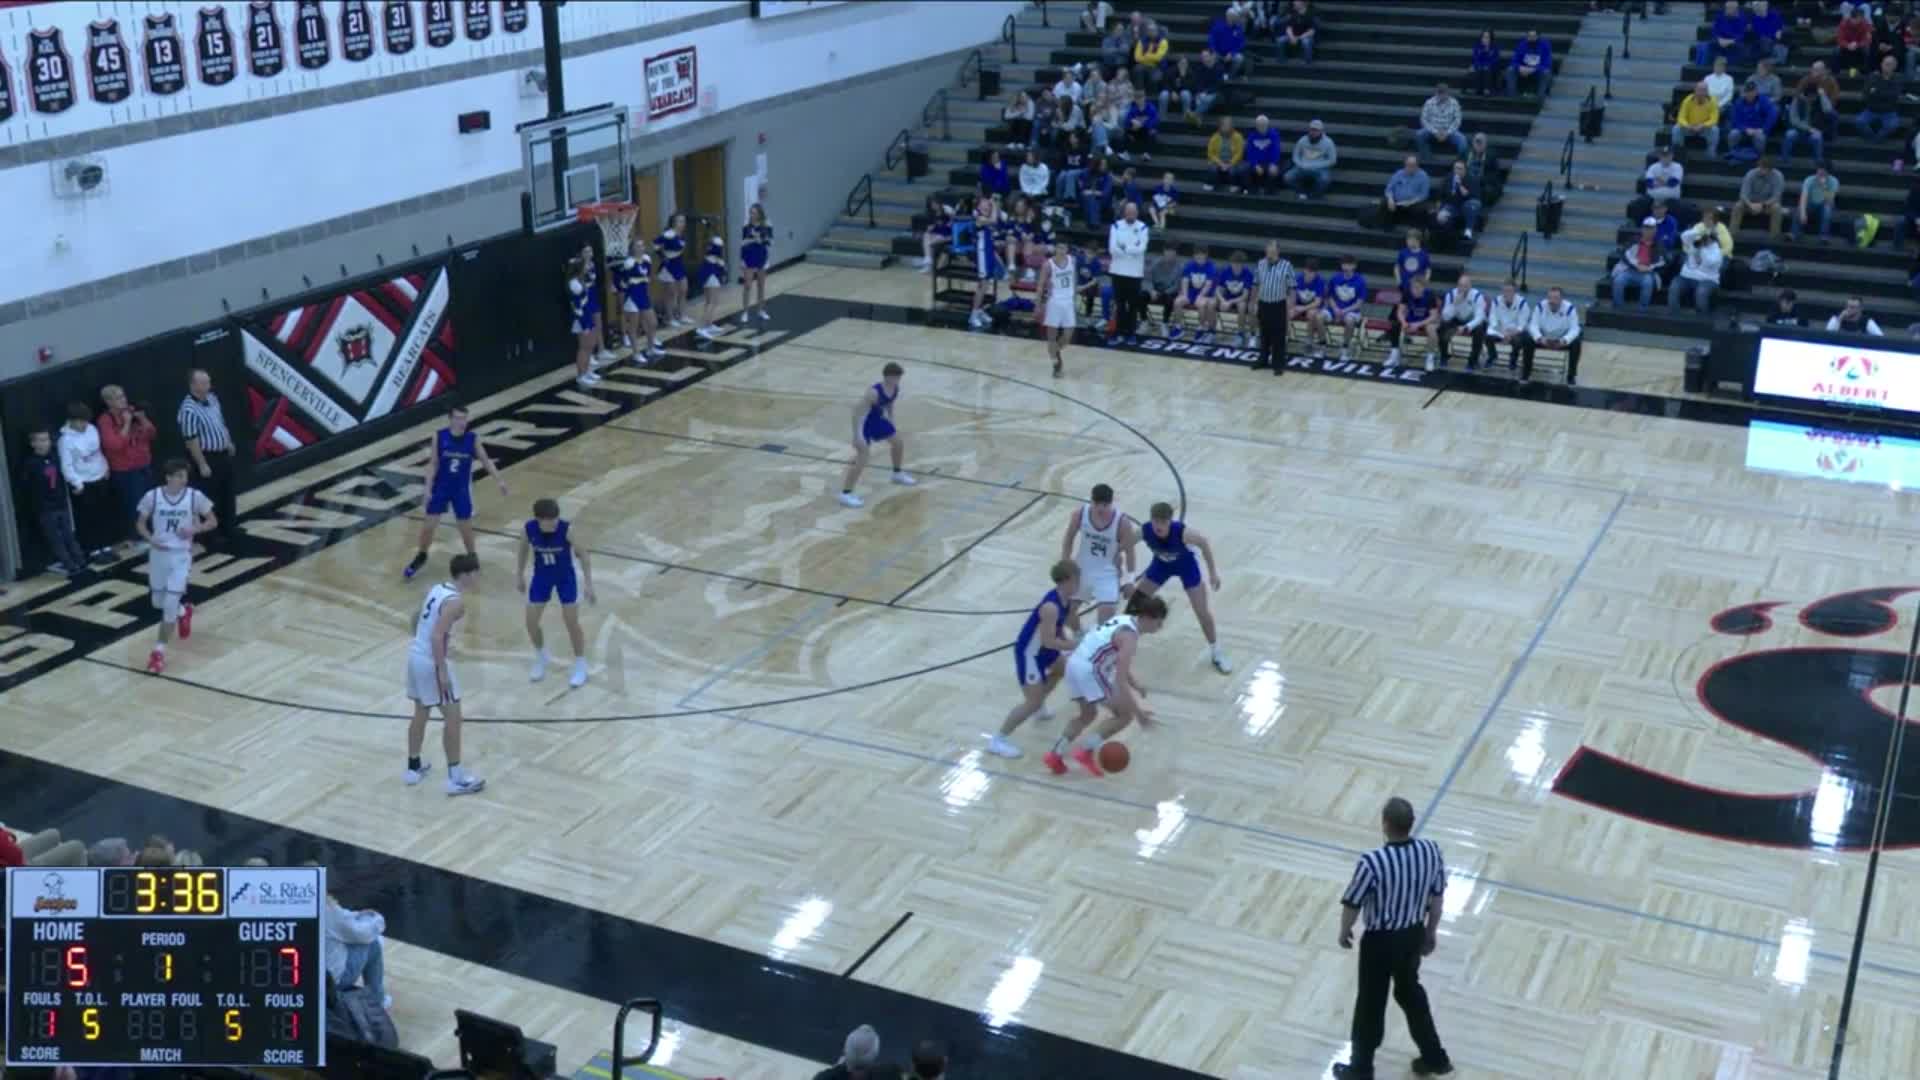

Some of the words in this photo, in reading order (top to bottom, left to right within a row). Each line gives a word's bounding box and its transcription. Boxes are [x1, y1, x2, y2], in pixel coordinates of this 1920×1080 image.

[392, 7, 406, 26] 31
[432, 1, 446, 20] 31
[306, 18, 318, 41] 11
[349, 12, 364, 33] 21
[206, 32, 224, 55] 15
[256, 25, 273, 47] 21
[96, 47, 121, 71] 45
[154, 40, 173, 64] 13
[37, 55, 63, 81] 30
[1138, 338, 1425, 383] SPENCRVILLE
[255, 349, 342, 428] SPENCERVILLE
[449, 458, 460, 473] 2
[541, 552, 556, 565] 11
[1090, 541, 1107, 558] 24
[422, 597, 436, 620] 5
